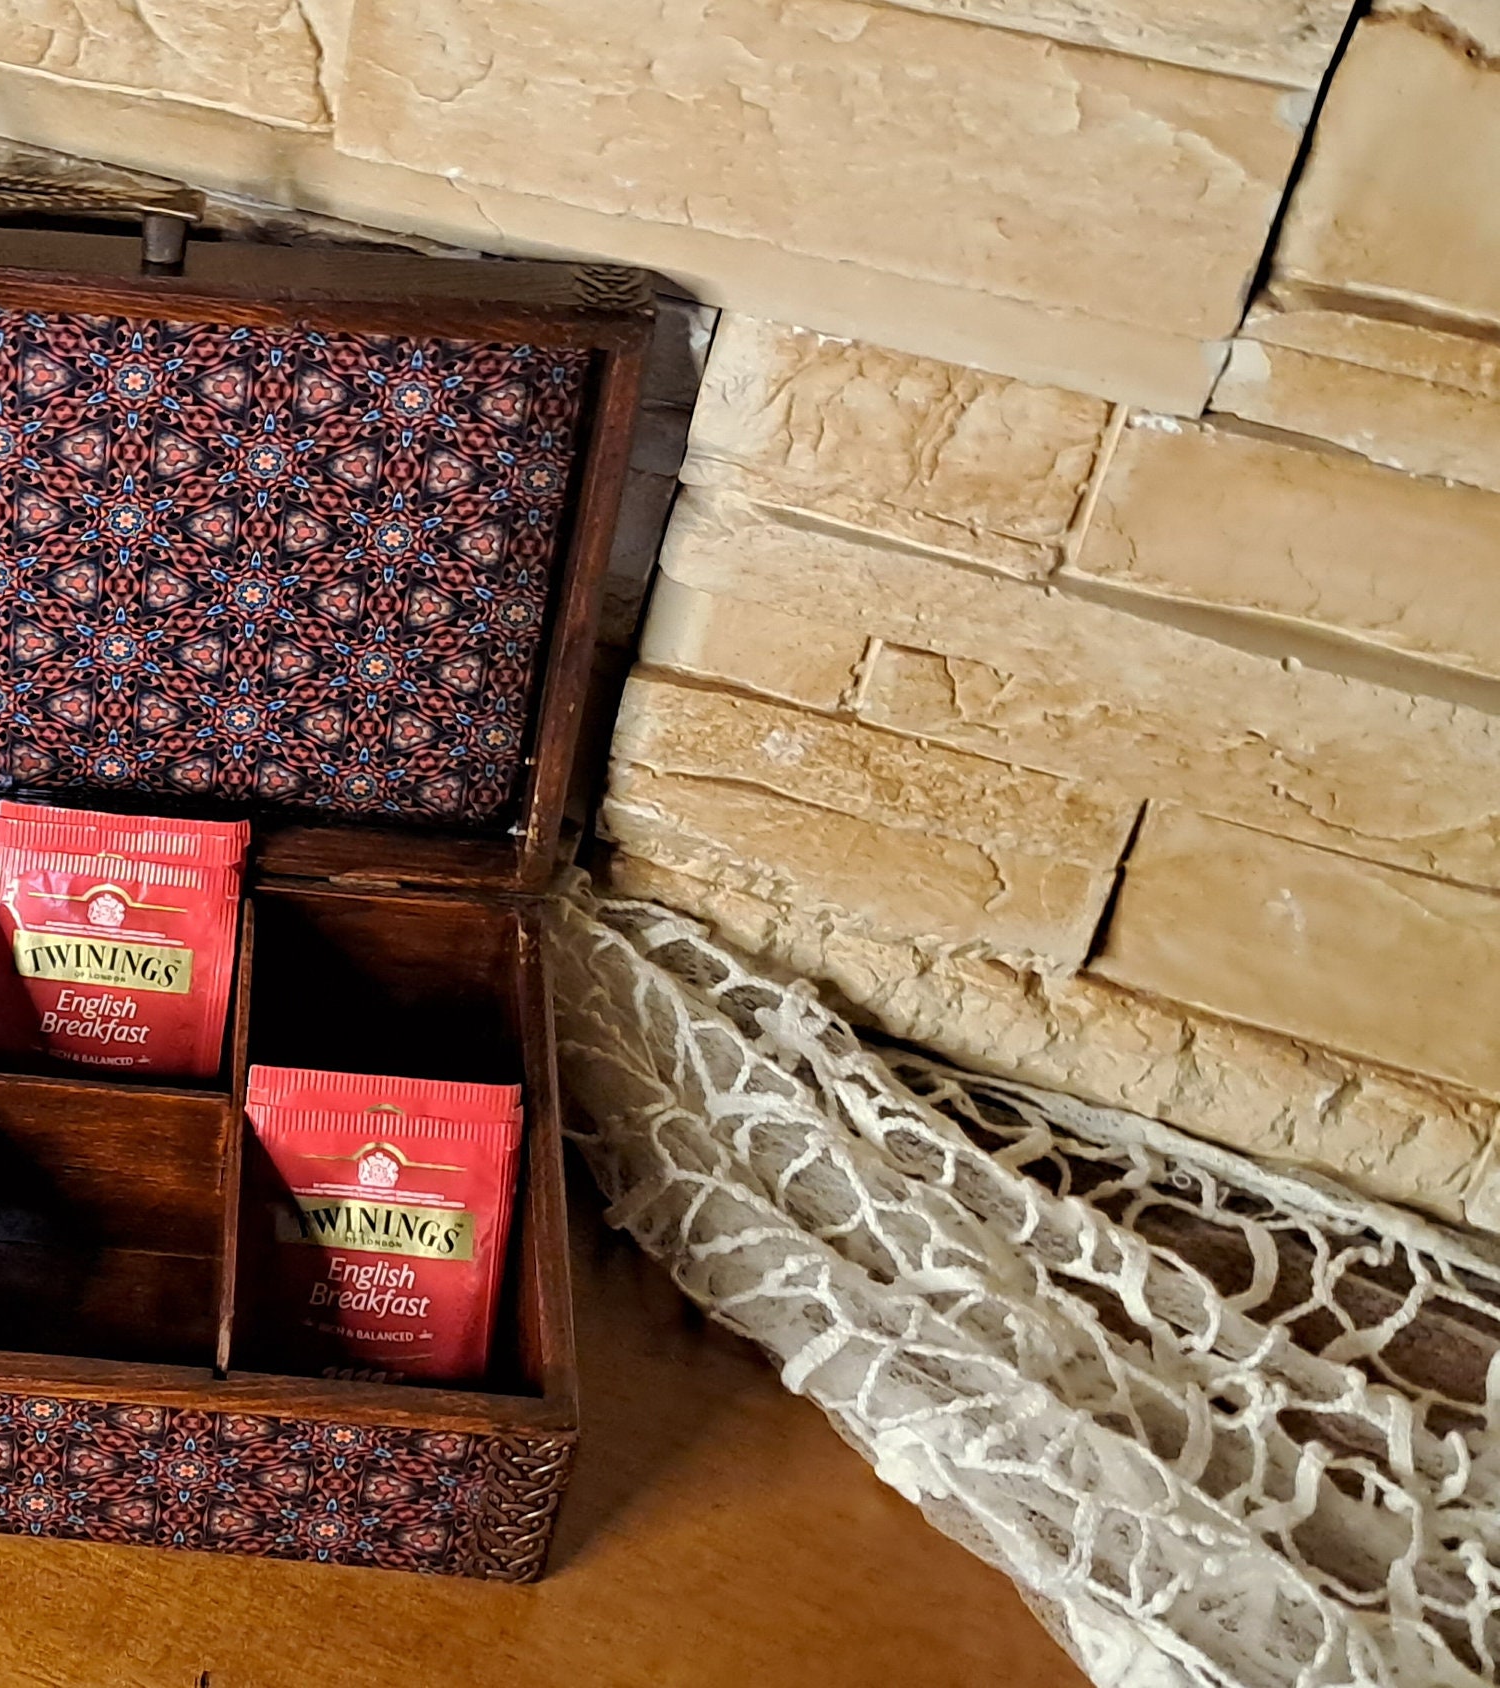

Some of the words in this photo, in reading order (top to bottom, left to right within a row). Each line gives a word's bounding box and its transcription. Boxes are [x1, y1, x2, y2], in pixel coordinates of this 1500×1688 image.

[25, 943, 179, 988] TWININGS
[56, 989, 137, 1020] English
[40, 1011, 151, 1045] Breakfast
[81, 1053, 134, 1067] BALANCED
[296, 1205, 460, 1255] TWININGS
[327, 1256, 415, 1290] English
[309, 1281, 430, 1318] Breakfast
[356, 1328, 415, 1343] BALANCED
